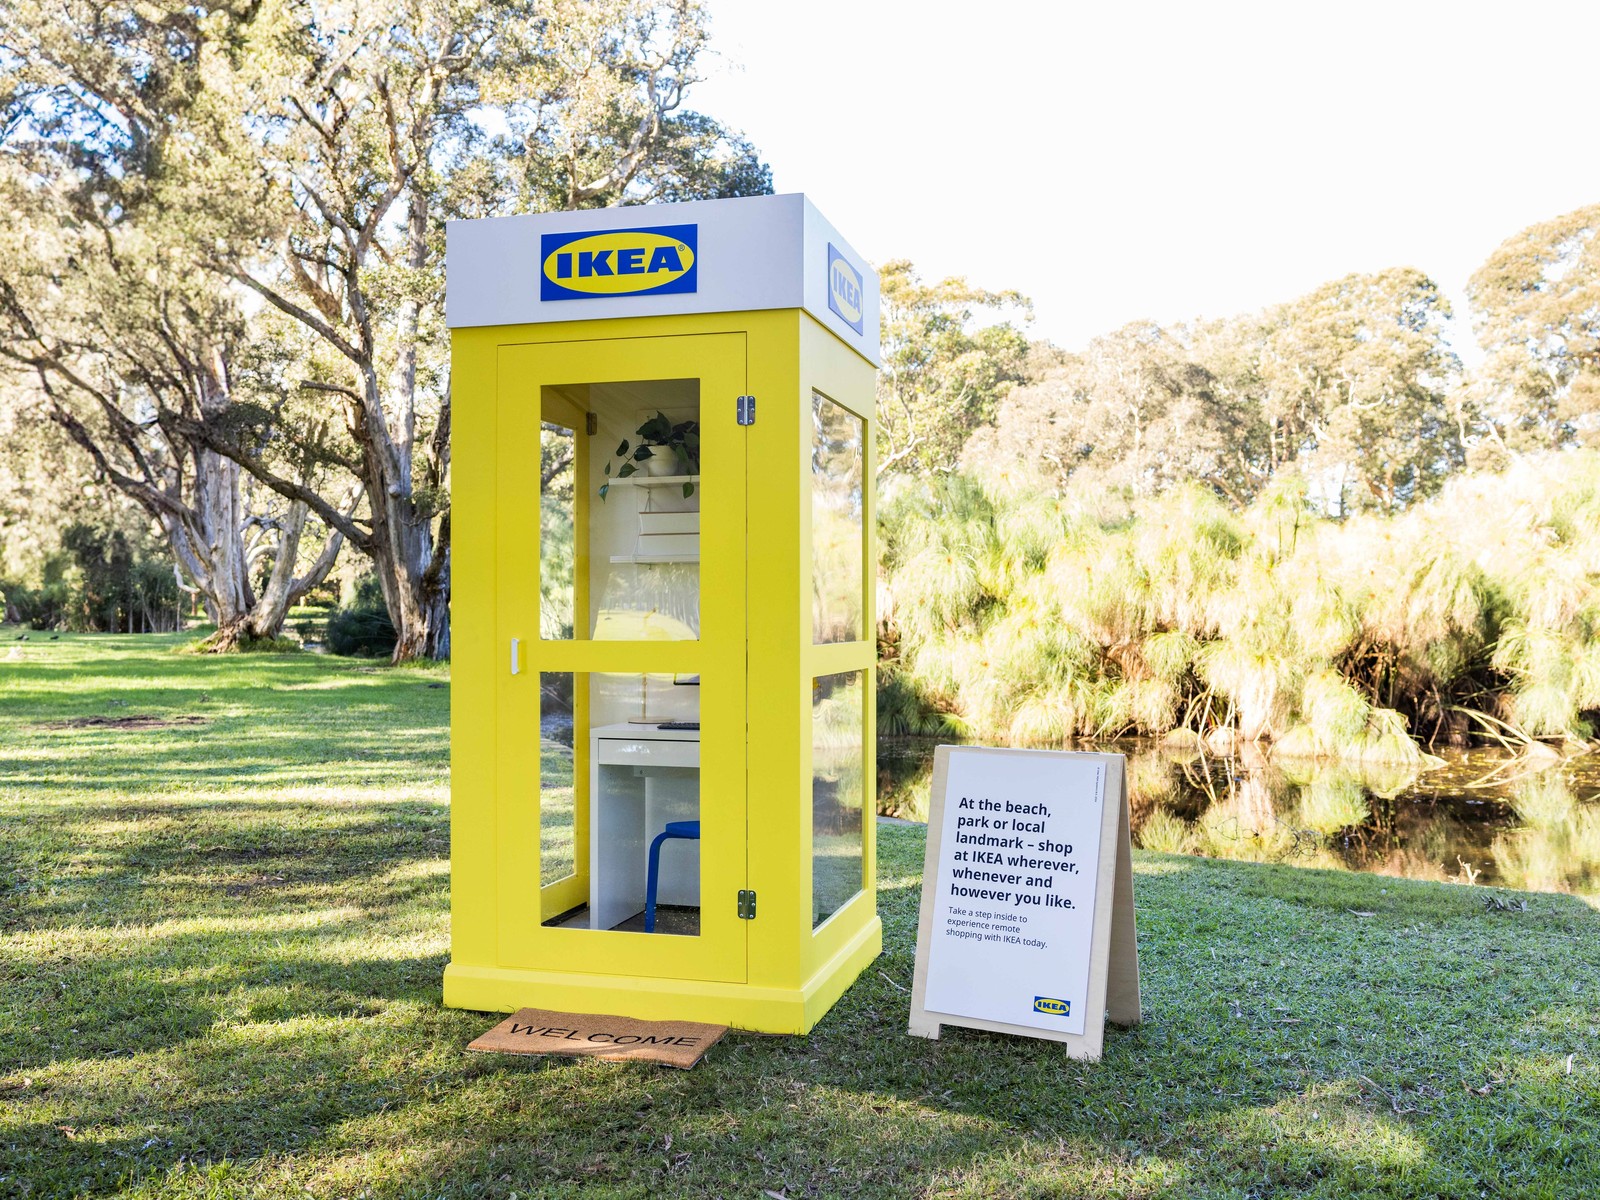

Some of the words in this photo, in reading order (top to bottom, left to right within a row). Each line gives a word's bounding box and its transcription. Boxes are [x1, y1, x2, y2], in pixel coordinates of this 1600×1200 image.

[833, 265, 861, 314] IKEA
[958, 797, 975, 810] At
[978, 798, 1001, 812] the
[1005, 800, 1051, 818] beach,
[957, 816, 990, 829] park
[993, 820, 1009, 830] or
[1012, 818, 1045, 834] local
[956, 831, 1024, 850] landmark
[1038, 839, 1073, 857] shop
[954, 850, 968, 862] at
[972, 850, 1004, 866] IKEA
[1007, 855, 1079, 875] wherever,
[952, 867, 1023, 885] whenever
[1025, 876, 1053, 889] and
[950, 883, 1012, 902] however
[1014, 893, 1041, 907] you
[1045, 893, 1076, 910] like.
[947, 917, 990, 930] experience
[991, 923, 1021, 934] remote
[948, 906, 967, 916] Take
[975, 910, 992, 920] step
[993, 912, 1018, 922] inside
[1019, 915, 1028, 924] to
[945, 928, 983, 942] shopping
[984, 933, 1001, 942] with
[1003, 935, 1021, 945] IKEA
[1022, 938, 1048, 950] today.
[1037, 1000, 1067, 1012] IKEA
[510, 1022, 702, 1048] WELCOME
